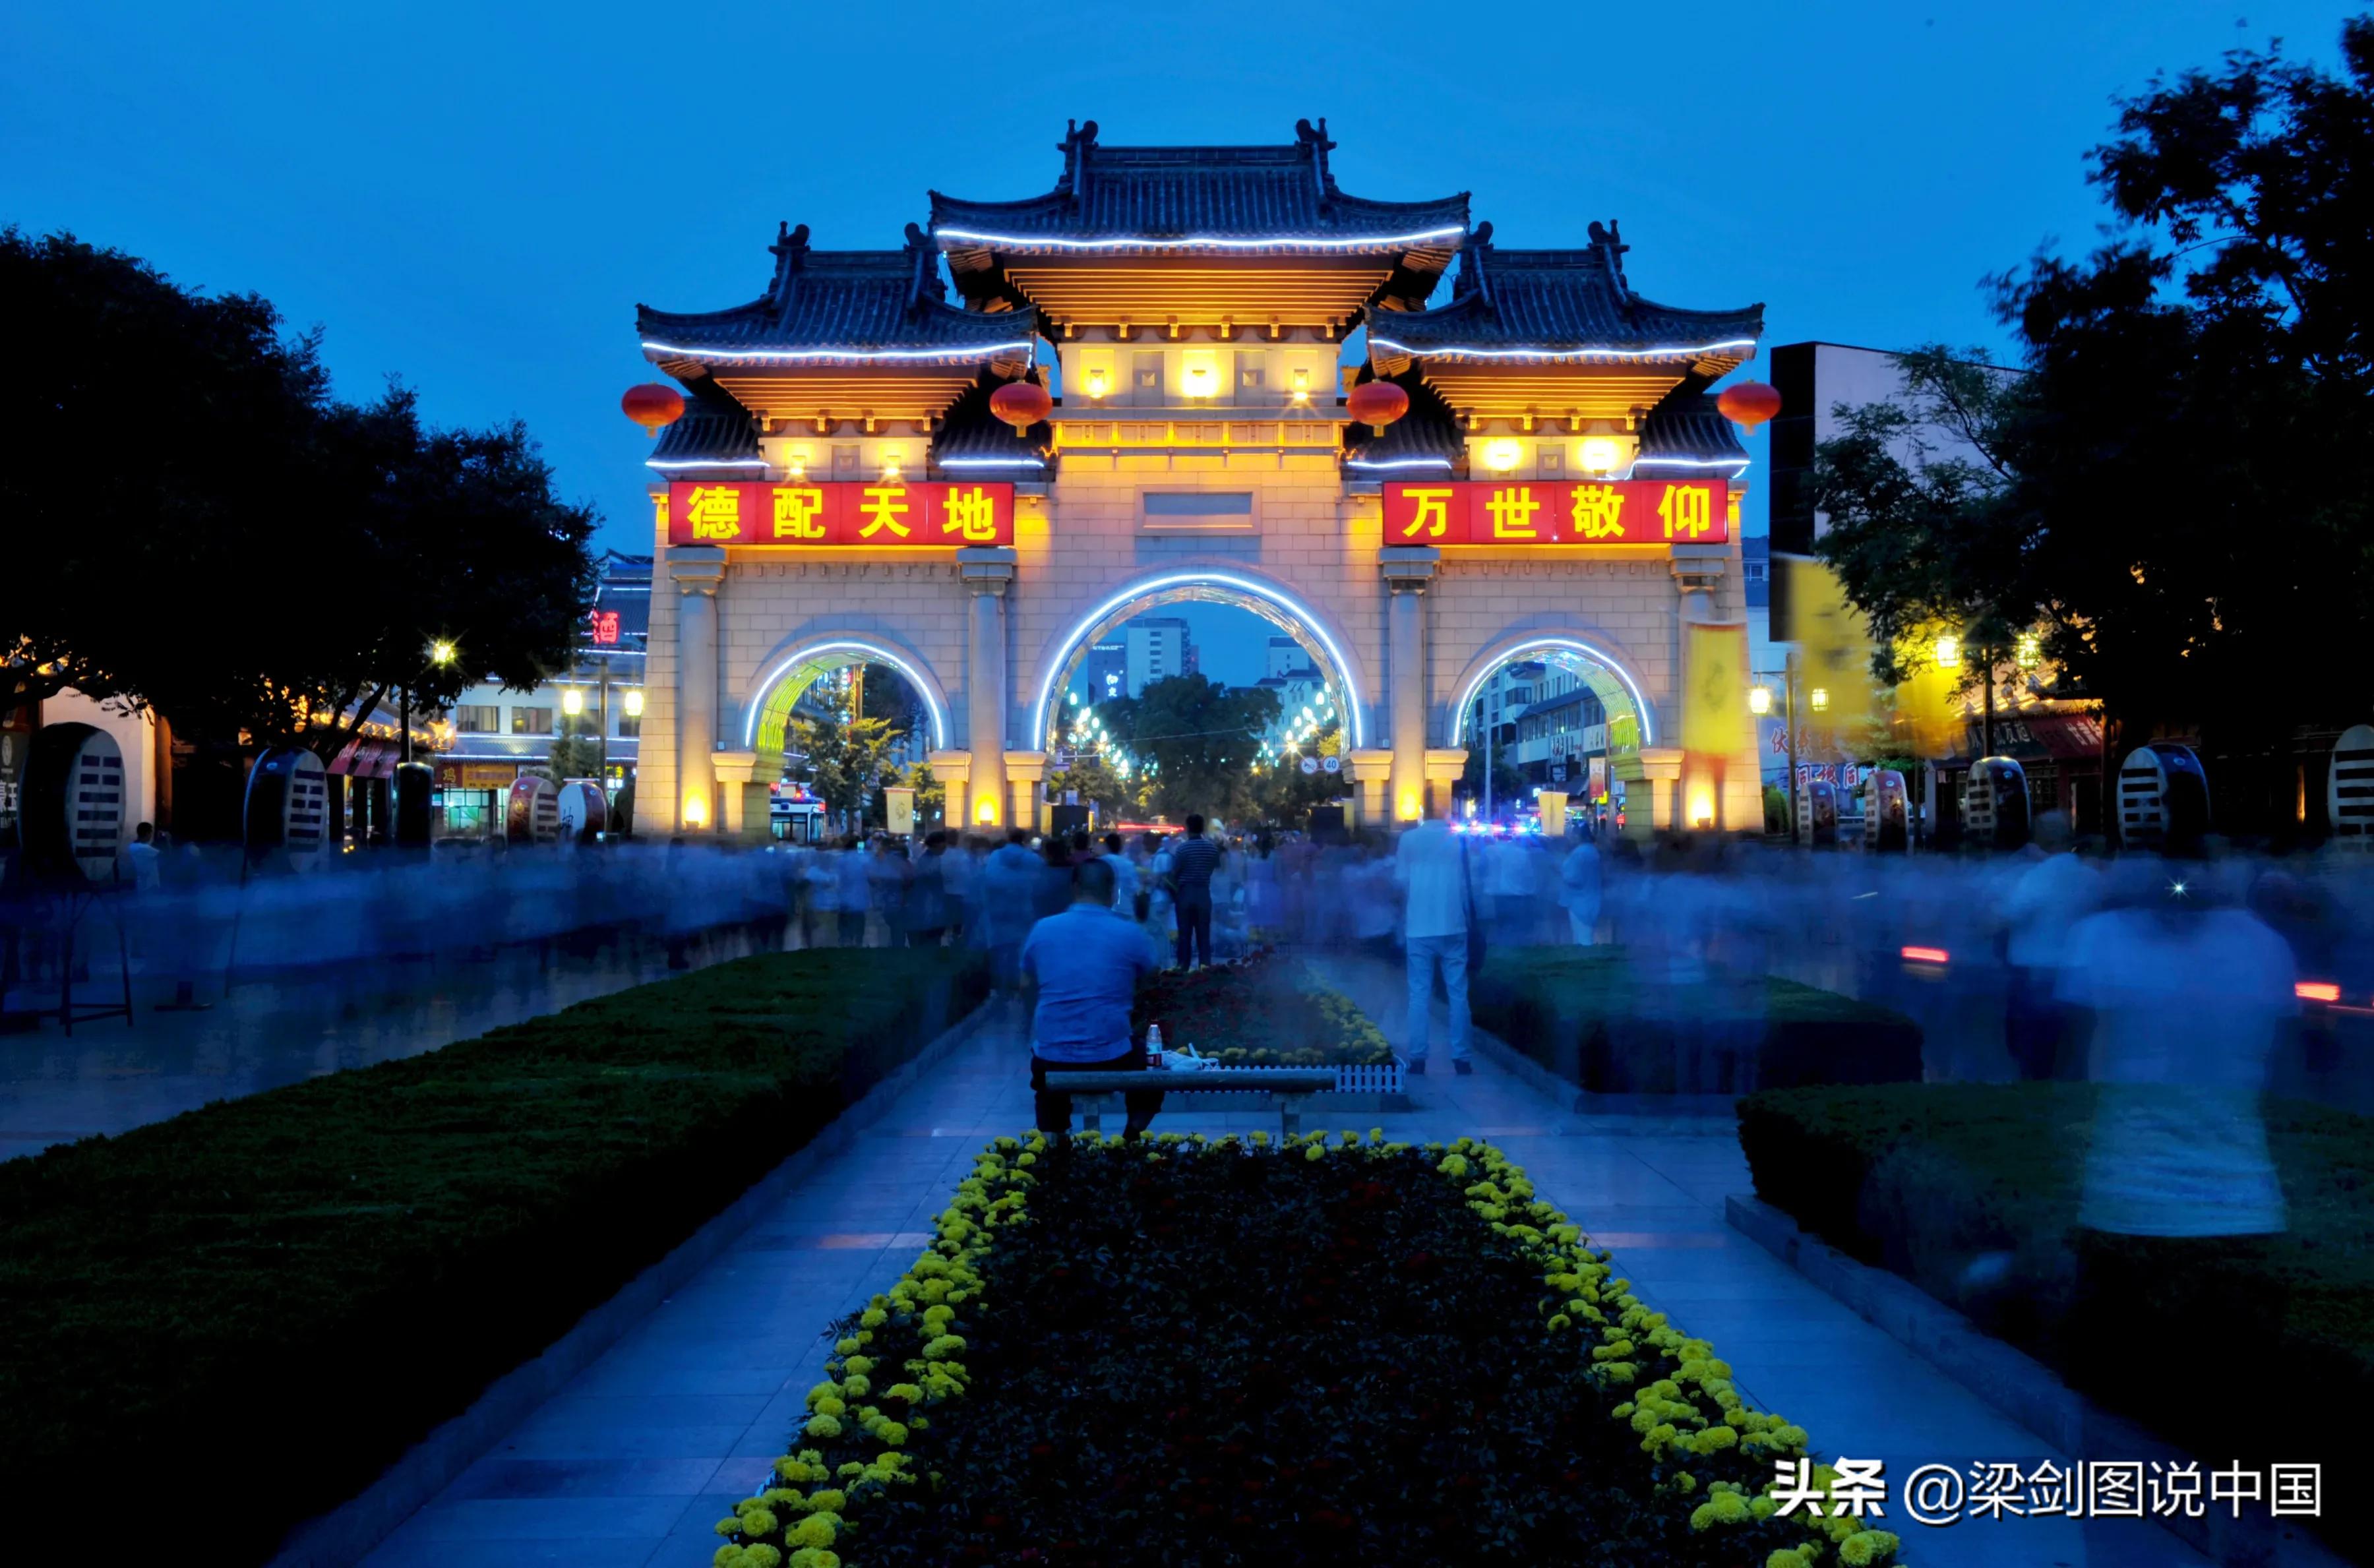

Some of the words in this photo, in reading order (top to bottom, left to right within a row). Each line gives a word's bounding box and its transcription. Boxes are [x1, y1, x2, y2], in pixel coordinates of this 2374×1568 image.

[687, 486, 996, 540] 德配天地
[1402, 485, 1710, 537] 万世敬仰
[1326, 760, 1336, 769] 40
